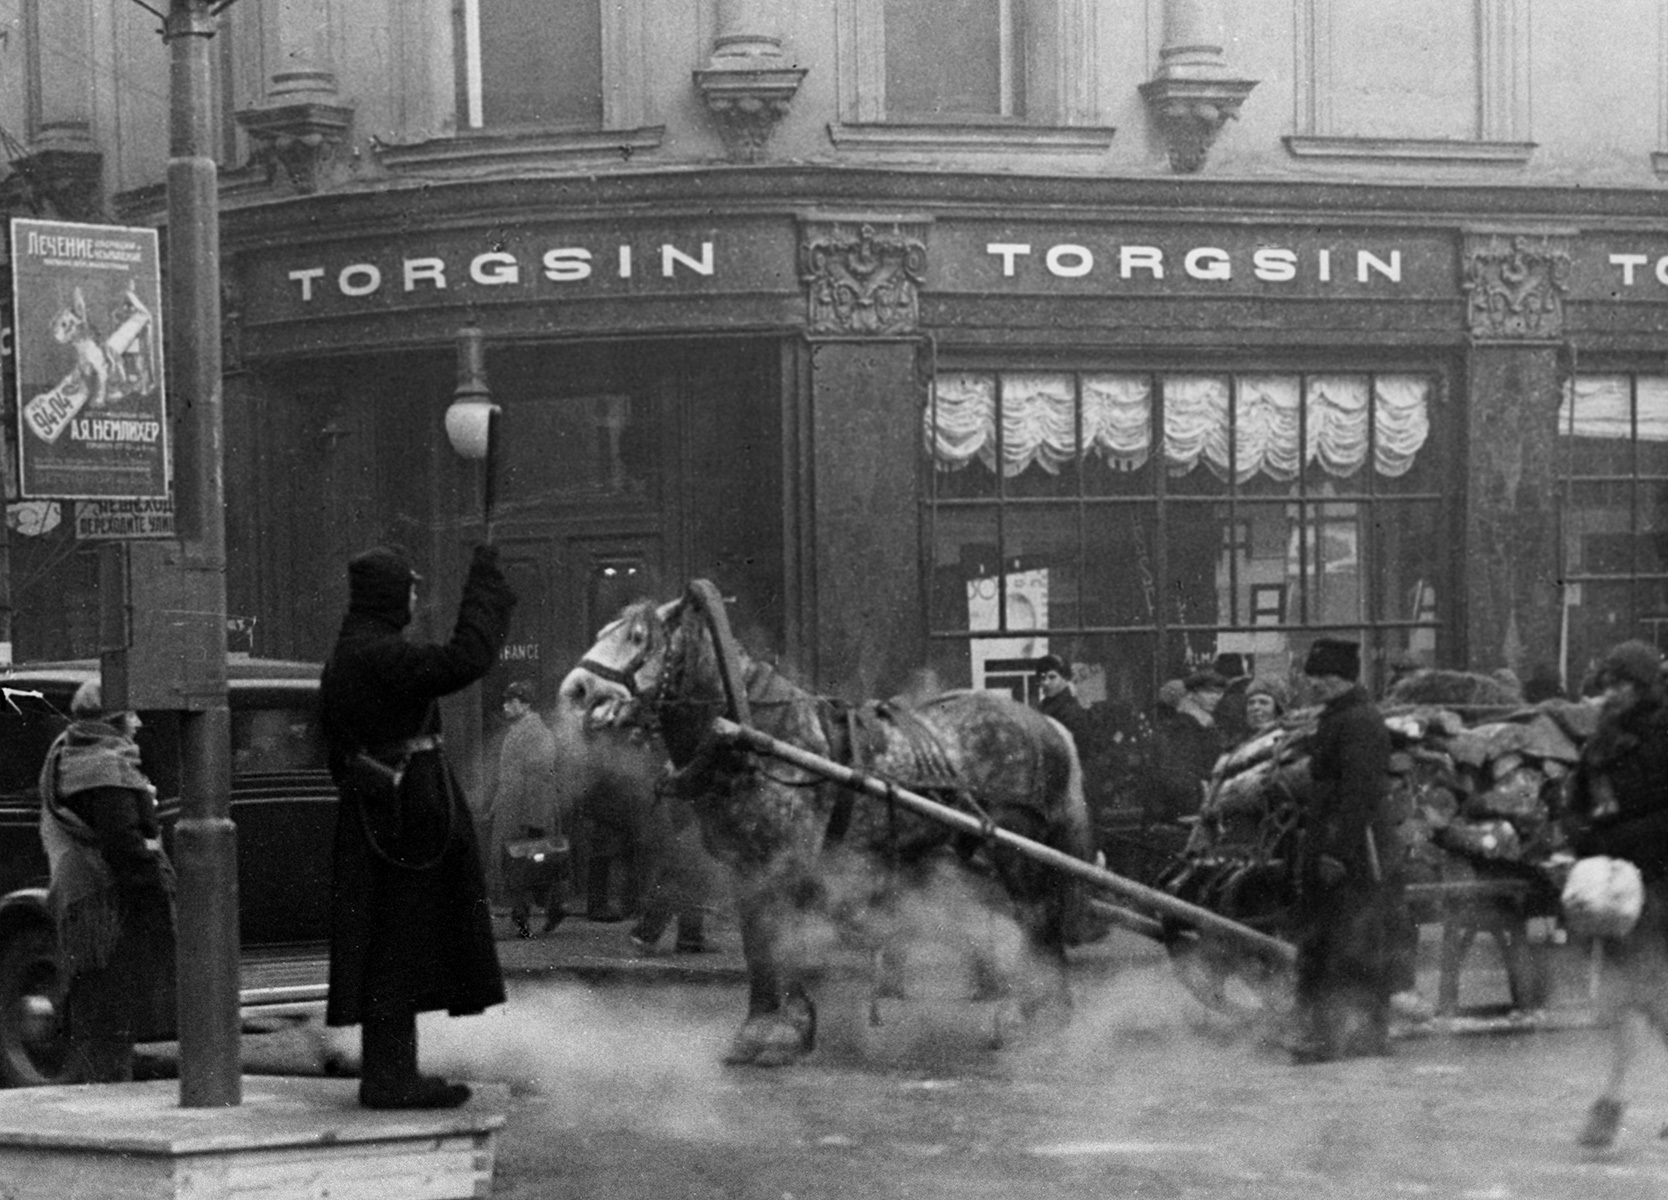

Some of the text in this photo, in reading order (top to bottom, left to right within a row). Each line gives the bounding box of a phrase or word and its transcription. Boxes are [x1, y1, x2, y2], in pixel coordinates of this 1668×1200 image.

[288, 242, 714, 300] TORGSIN
[986, 243, 1401, 283] TORGSIN
[1609, 254, 1668, 286] T
